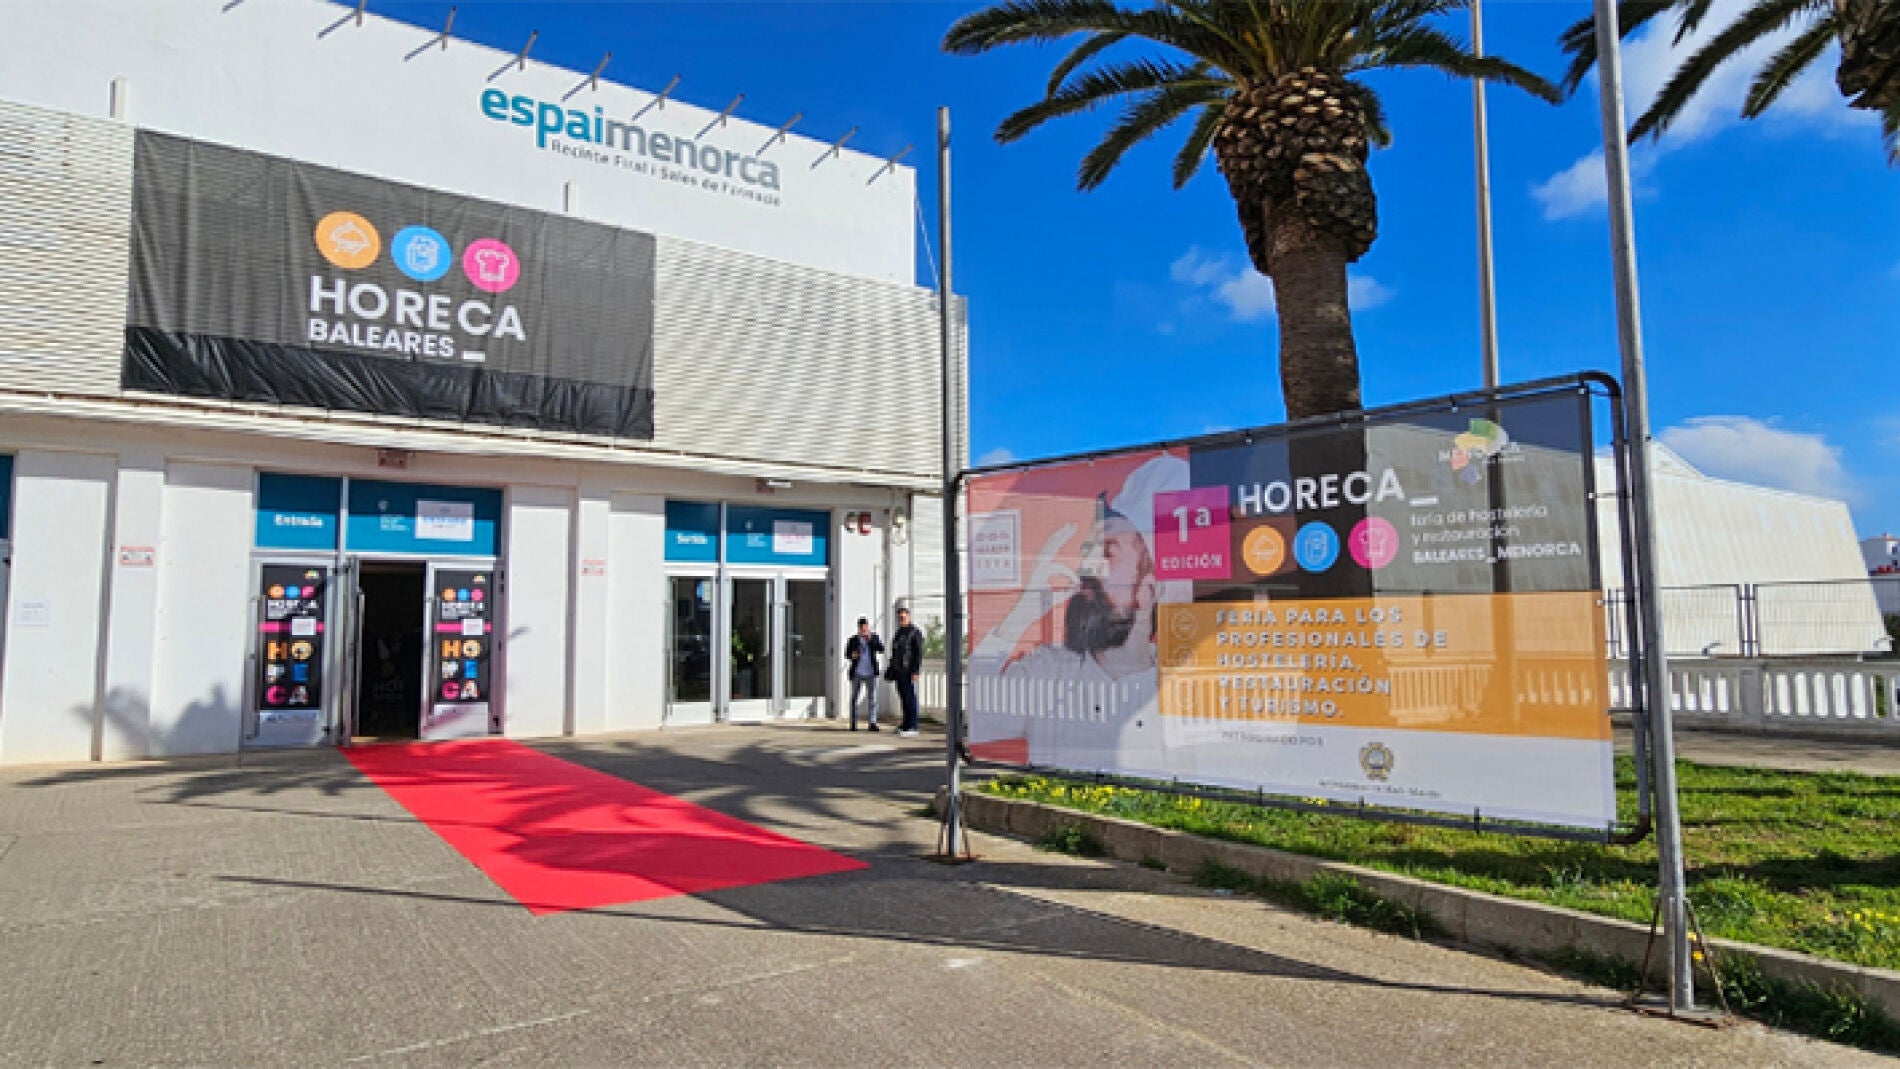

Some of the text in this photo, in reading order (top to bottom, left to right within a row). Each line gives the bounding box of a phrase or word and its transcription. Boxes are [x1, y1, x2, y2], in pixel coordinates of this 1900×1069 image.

[480, 87, 780, 191] espaimenorca
[309, 275, 527, 342] HORECA
[1216, 606, 1403, 625] FERIA PARA LOS
[1216, 630, 1448, 648] PROFESIONALES DE
[1218, 672, 1392, 696] RESTAURACIÓN
